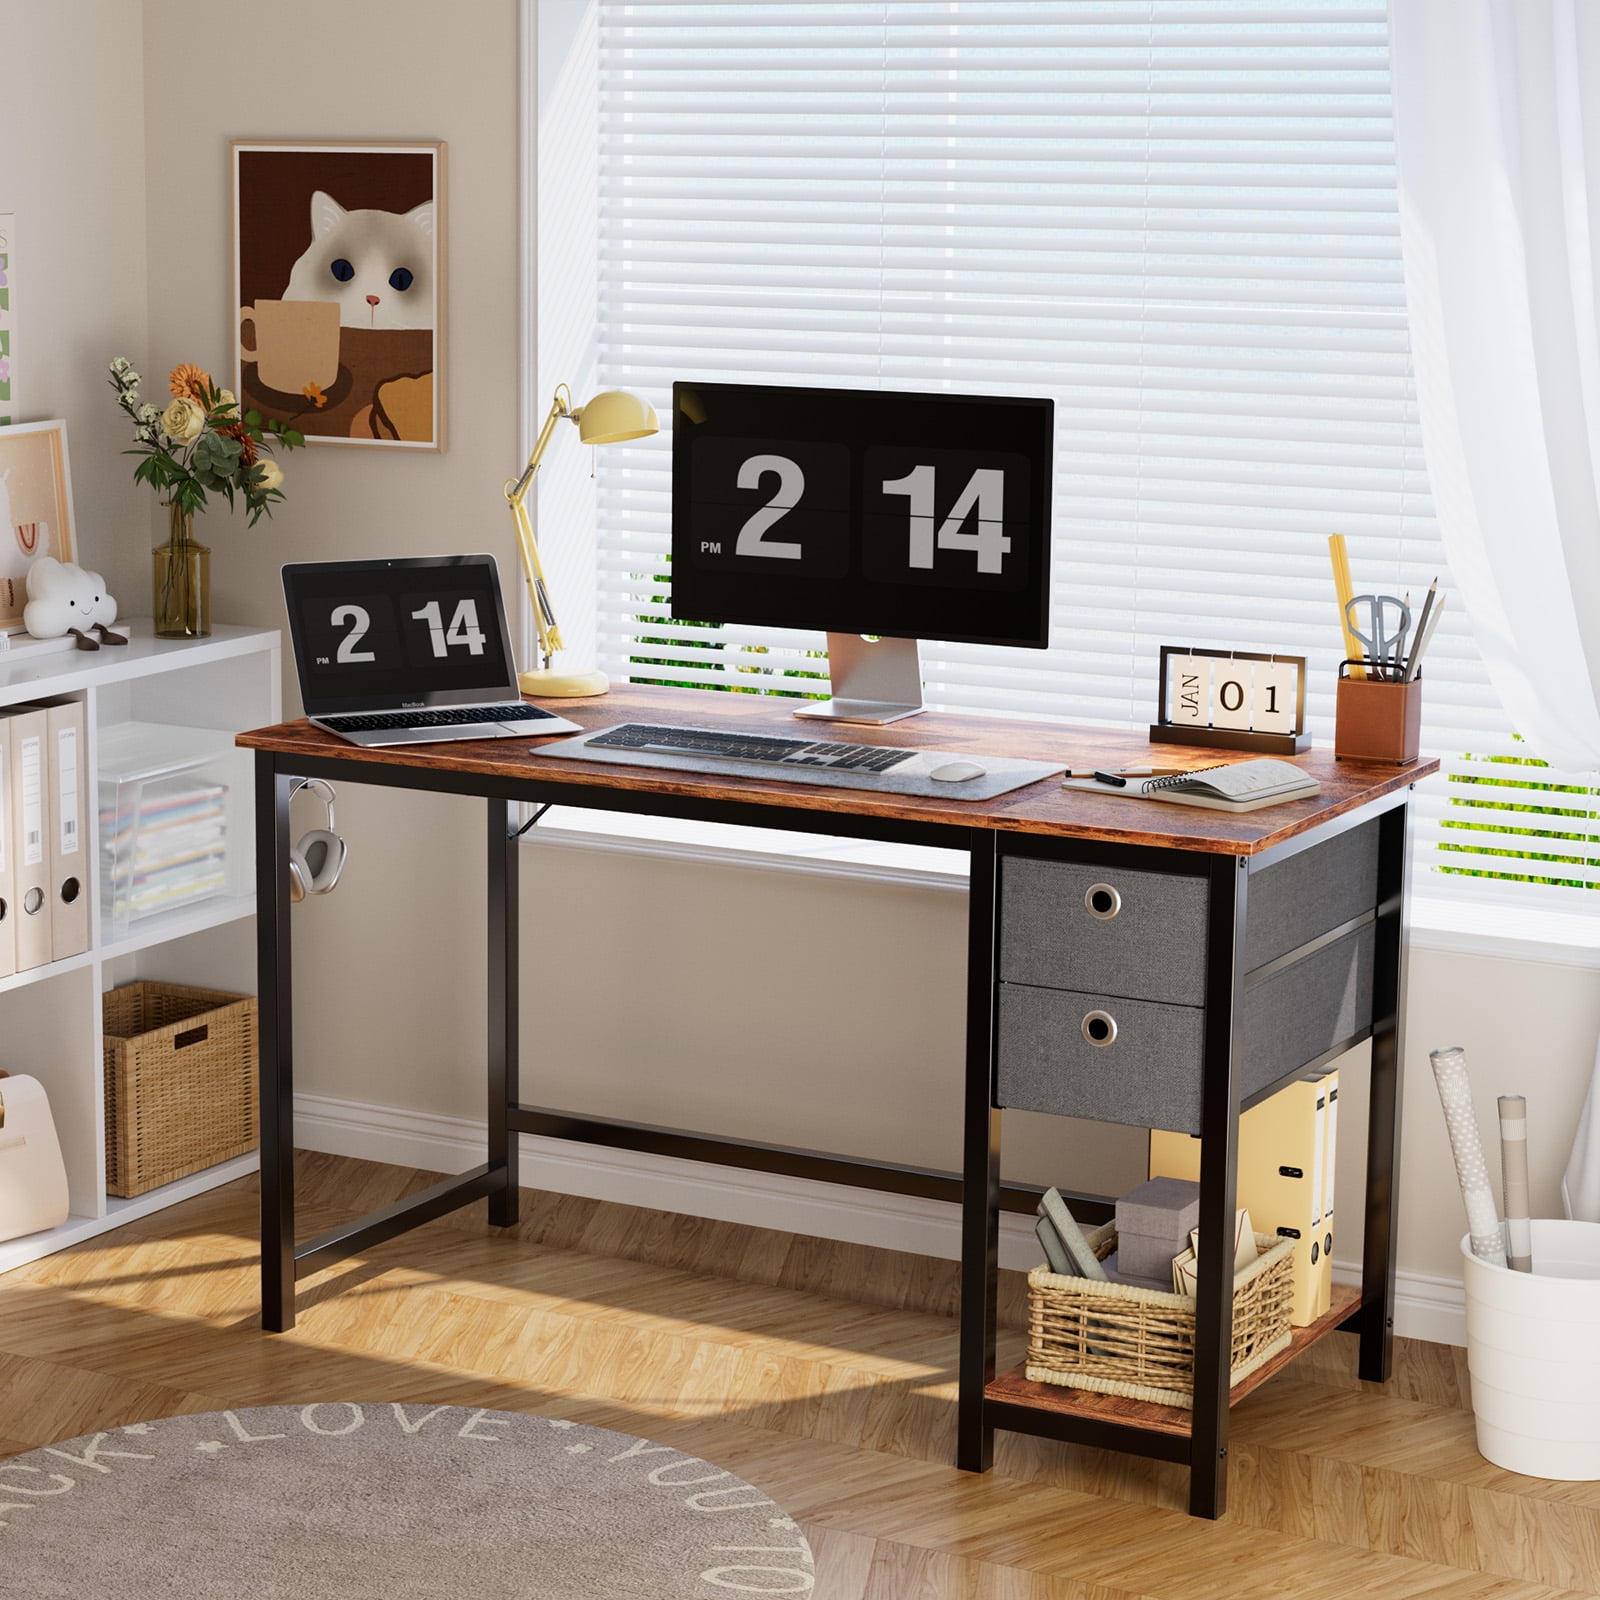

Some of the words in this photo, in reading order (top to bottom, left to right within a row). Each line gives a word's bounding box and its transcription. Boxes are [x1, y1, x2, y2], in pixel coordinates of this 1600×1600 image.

[700, 541, 722, 554] PM
[735, 454, 805, 560] 2
[882, 465, 1011, 574] 14
[316, 657, 330, 665] PM
[330, 604, 376, 664] 2
[411, 599, 487, 658] 14
[1181, 673, 1199, 717] JAN
[222, 1402, 511, 1442] LOVE
